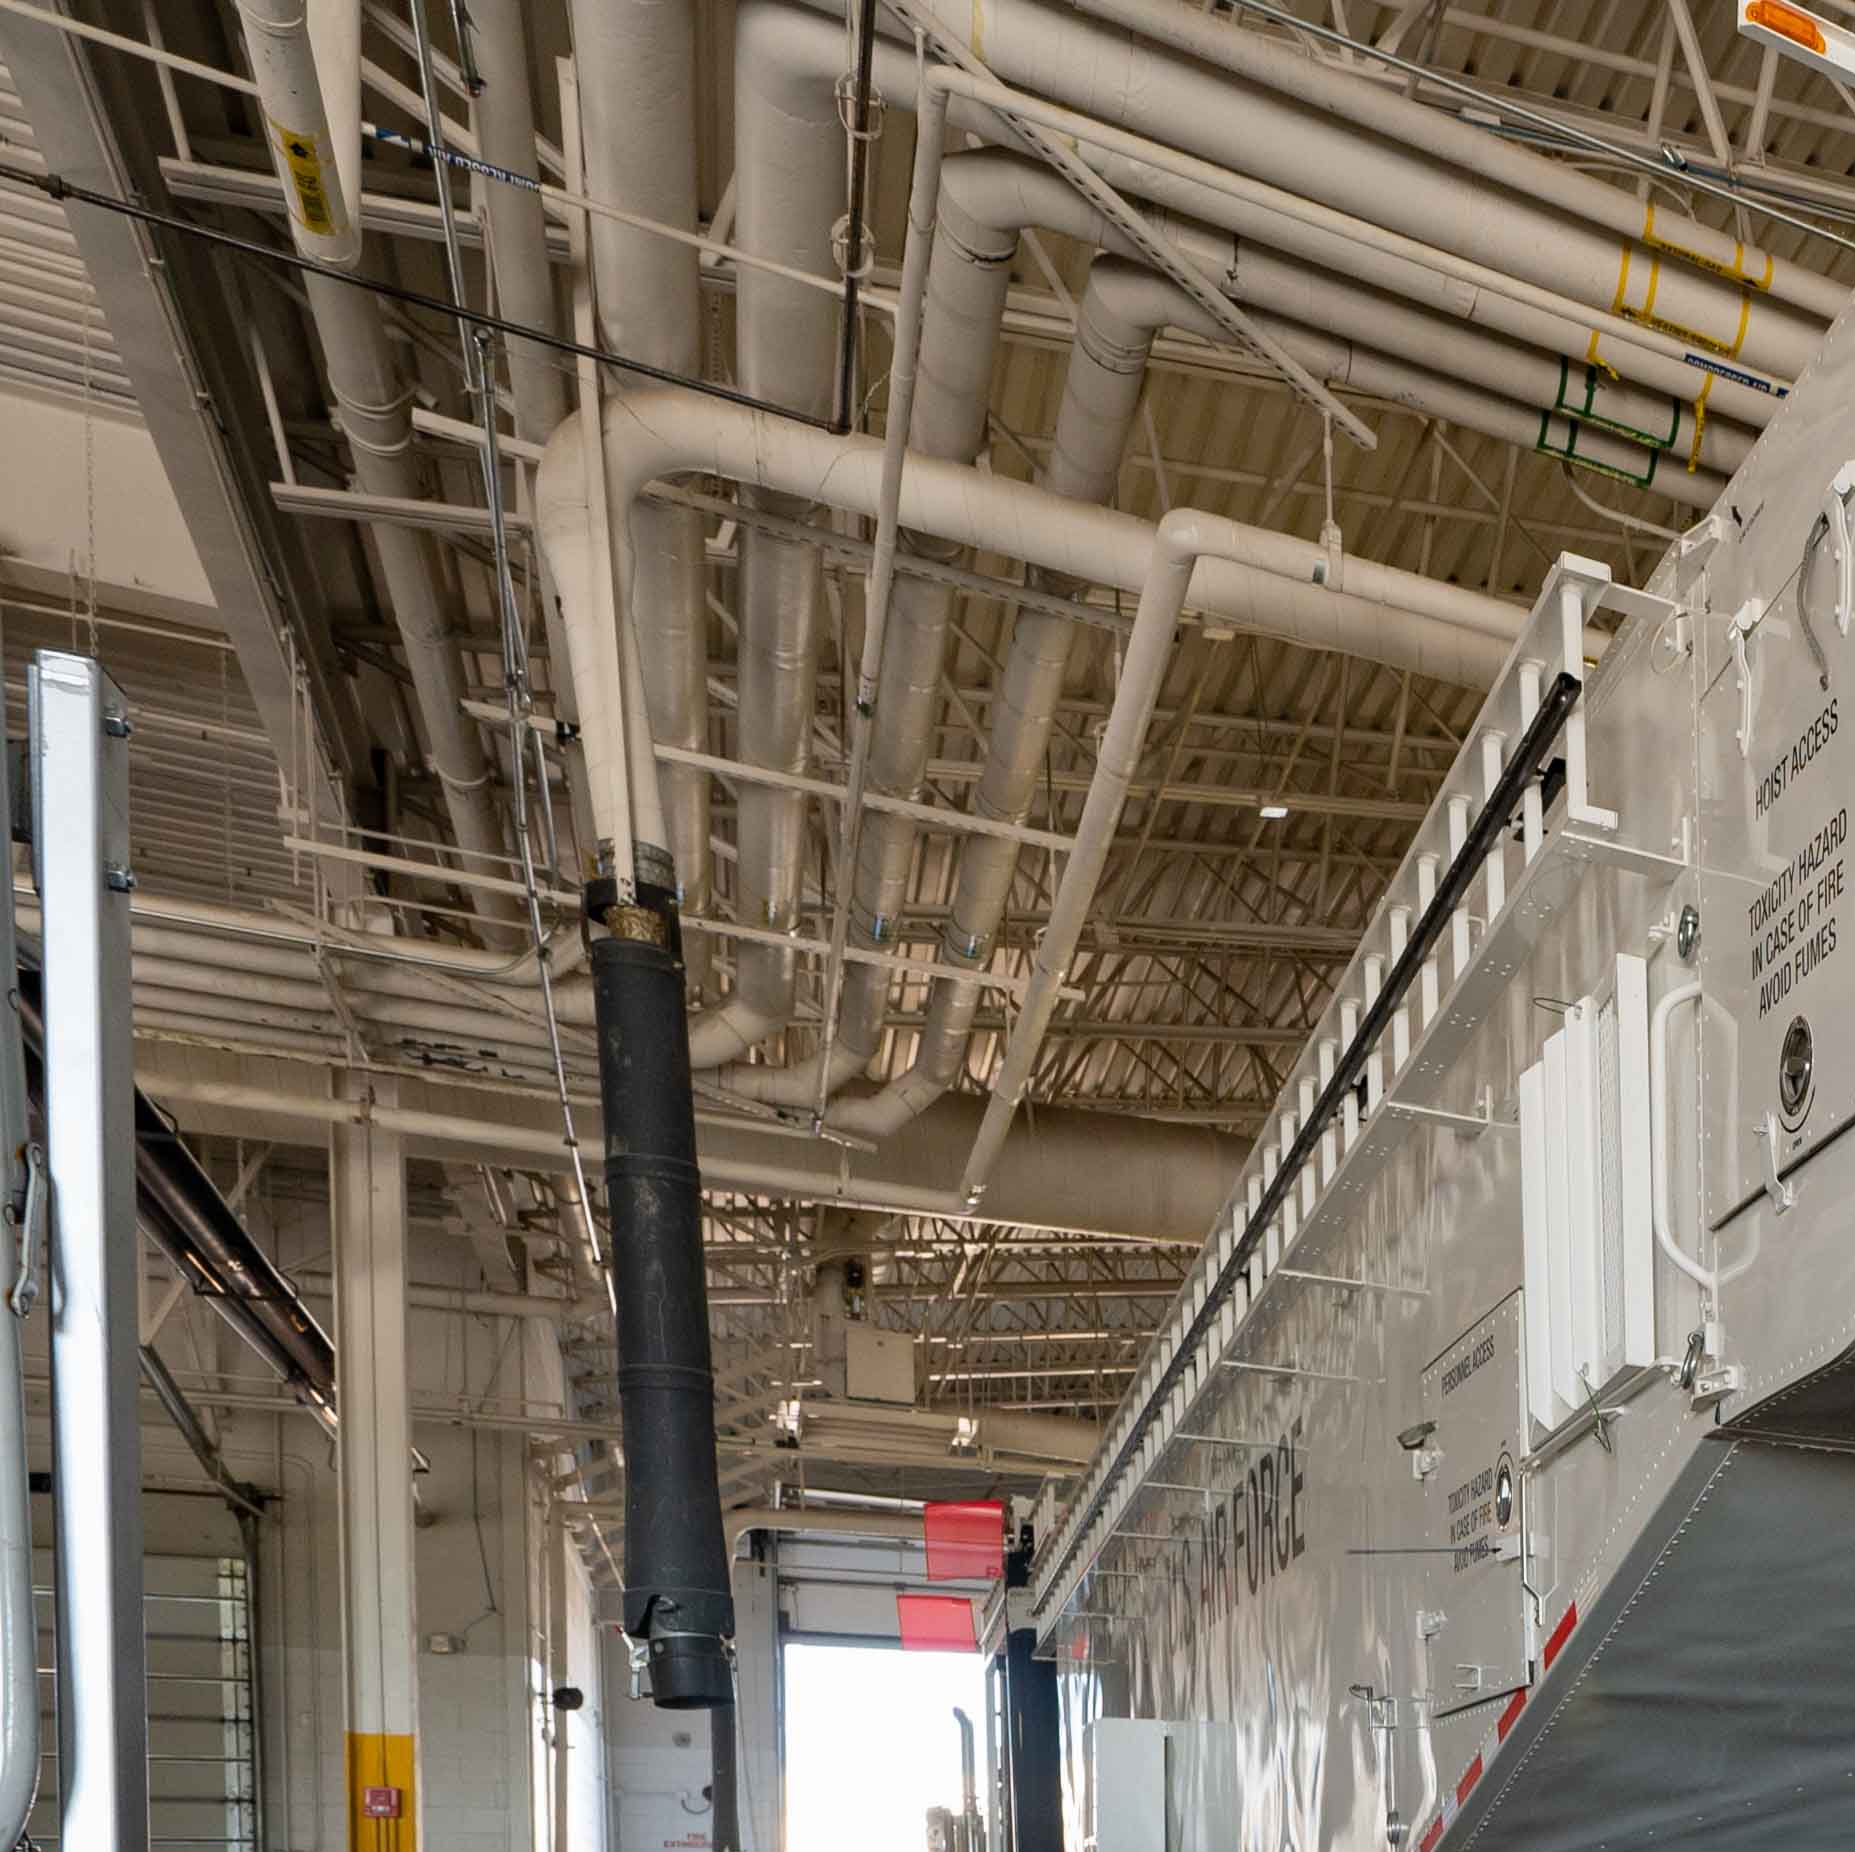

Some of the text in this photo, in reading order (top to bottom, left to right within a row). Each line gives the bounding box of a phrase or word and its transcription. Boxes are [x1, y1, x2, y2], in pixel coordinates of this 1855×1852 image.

[1755, 698, 1838, 821] HOIST ACCESS
[1748, 808, 1847, 937] TOXICITY HAZARD
[1752, 859, 1844, 980] IN CASE OF FIRE
[1759, 917, 1837, 1020] AVOID FUMES
[1441, 1335, 1495, 1400] PERSONNEL ACCESS
[1200, 1502, 1230, 1628] AIR
[1233, 1415, 1305, 1606] FORCE
[1457, 1513, 1469, 1541] CASE
[1480, 1500, 1492, 1530] FIRE
[1471, 1467, 1493, 1500] HAZARD
